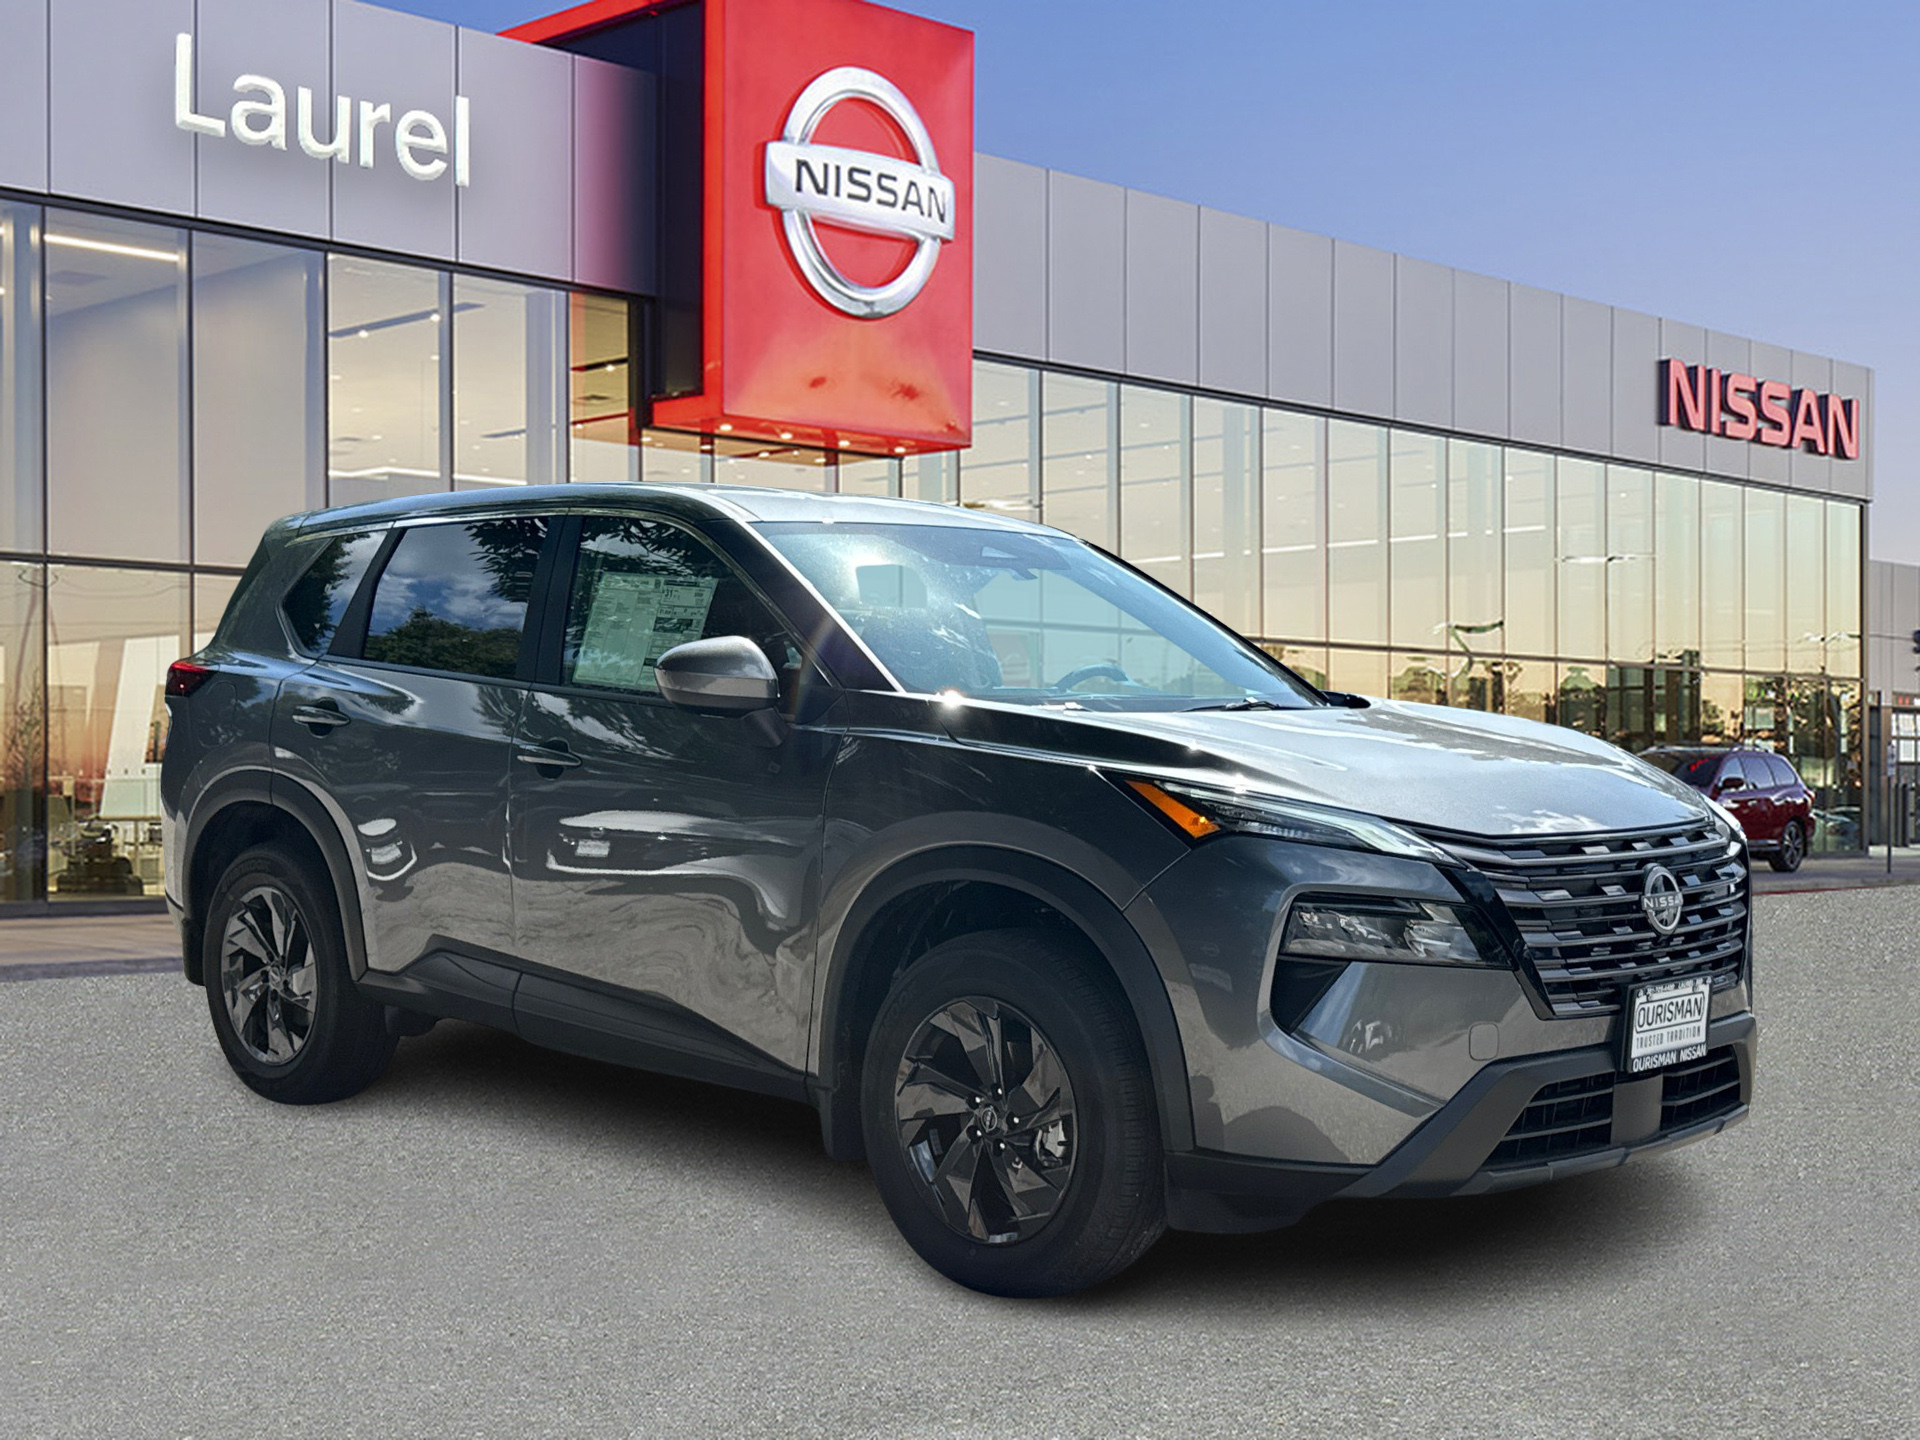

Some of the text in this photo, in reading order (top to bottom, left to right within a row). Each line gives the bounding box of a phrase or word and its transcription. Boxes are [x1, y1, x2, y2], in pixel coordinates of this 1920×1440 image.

[175, 32, 470, 188] Laurel
[794, 158, 946, 223] NISSAN
[1657, 358, 1860, 460] NISSAN
[1643, 895, 1683, 908] NISSA
[1637, 996, 1703, 1028] OURISMAN
[1636, 1026, 1701, 1050] TRUSTED TRADITION
[1632, 1043, 1707, 1072] OURISMAN NISSAN
